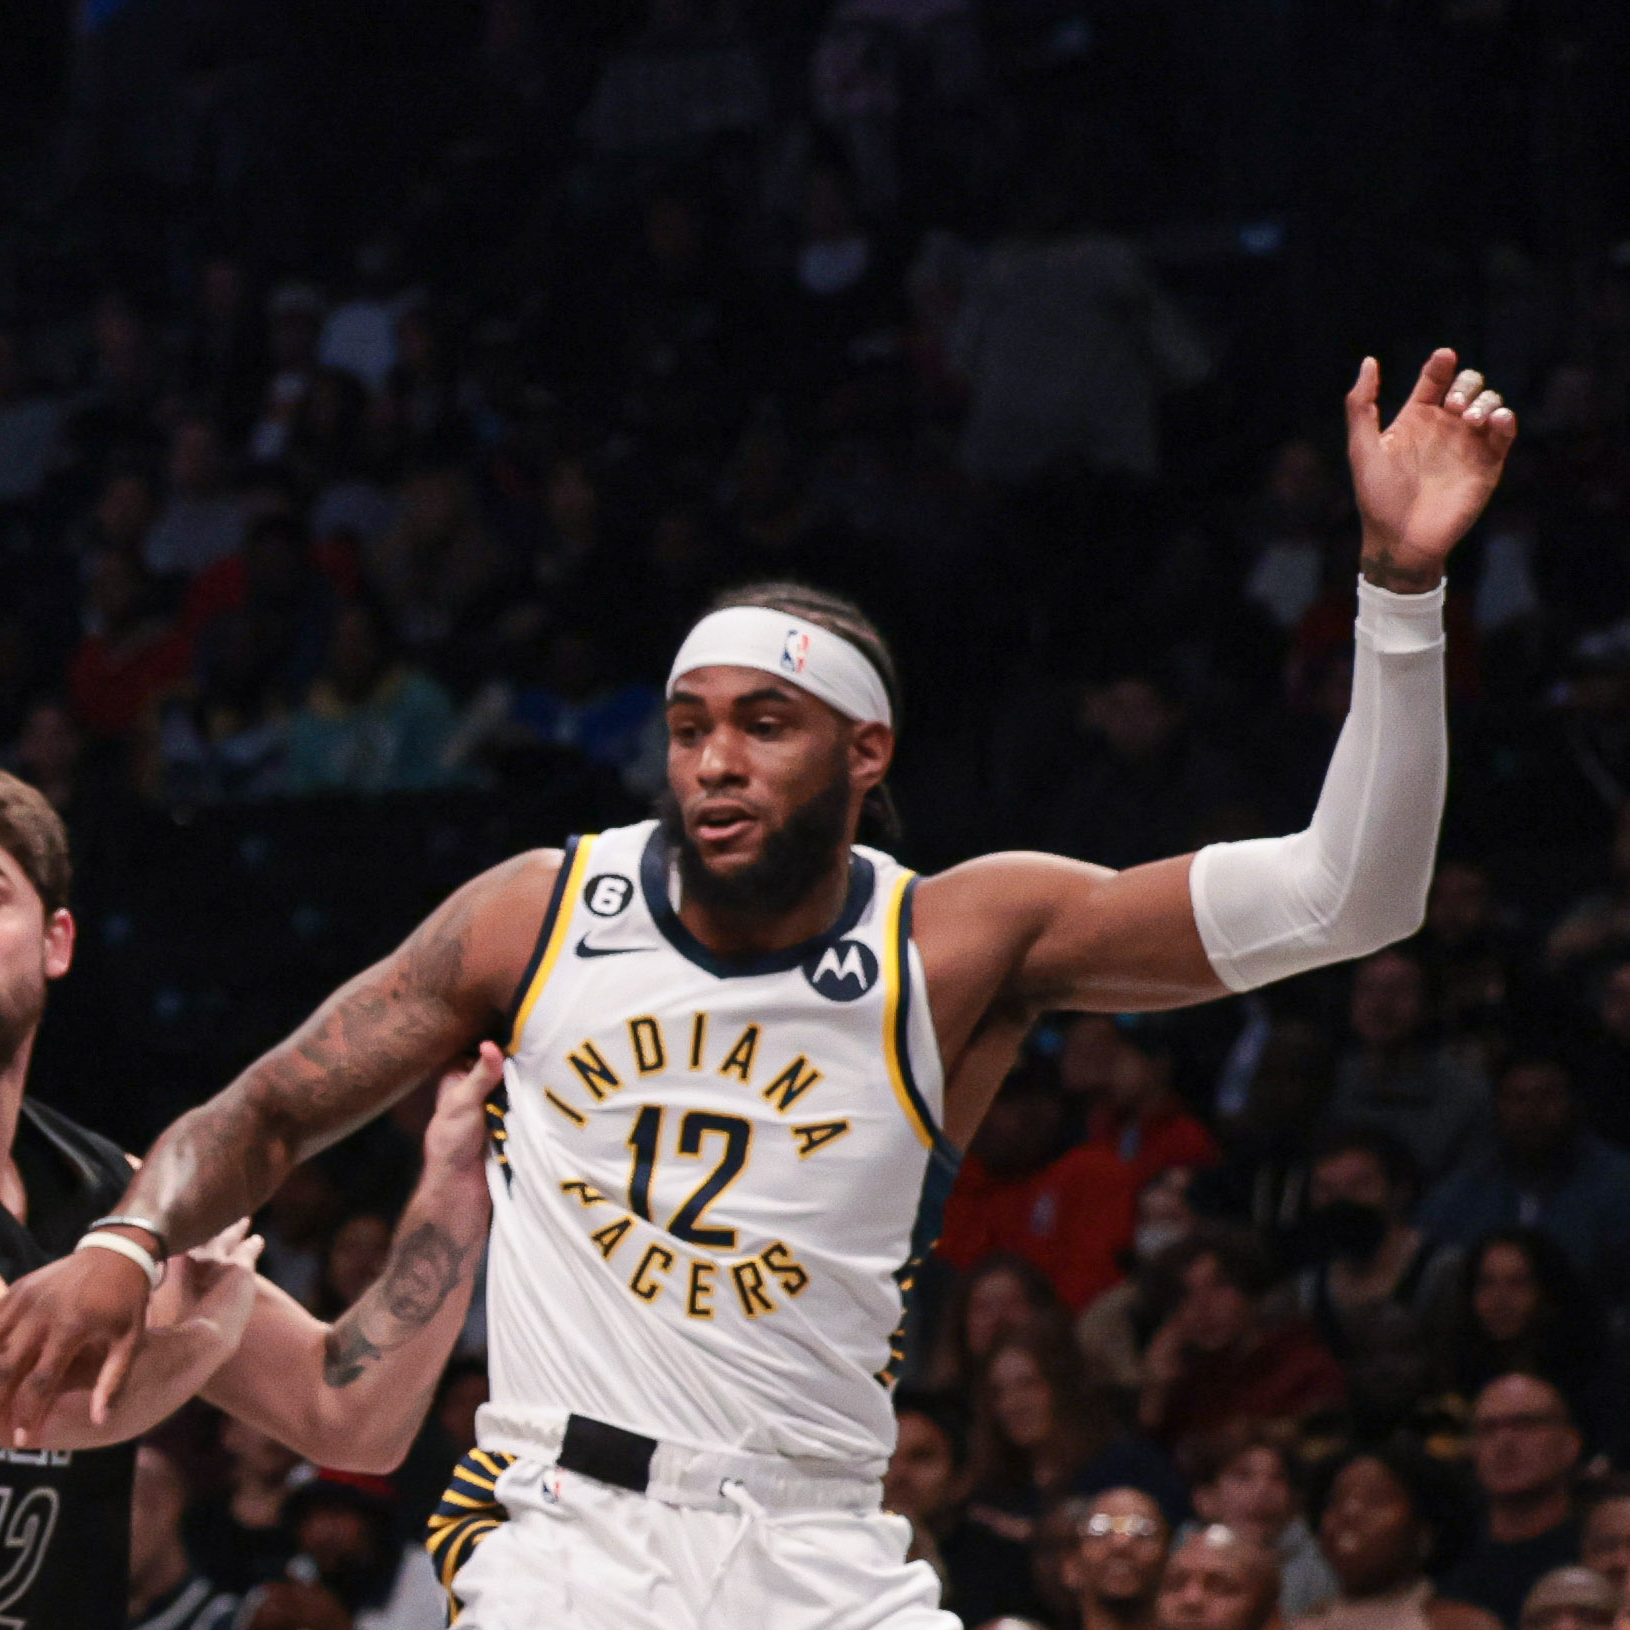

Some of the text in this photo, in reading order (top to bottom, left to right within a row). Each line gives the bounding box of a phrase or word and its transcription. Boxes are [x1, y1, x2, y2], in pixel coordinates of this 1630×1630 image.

[599, 878, 629, 911] 6
[544, 1012, 851, 1159] INDIANA
[626, 1104, 753, 1250] 12
